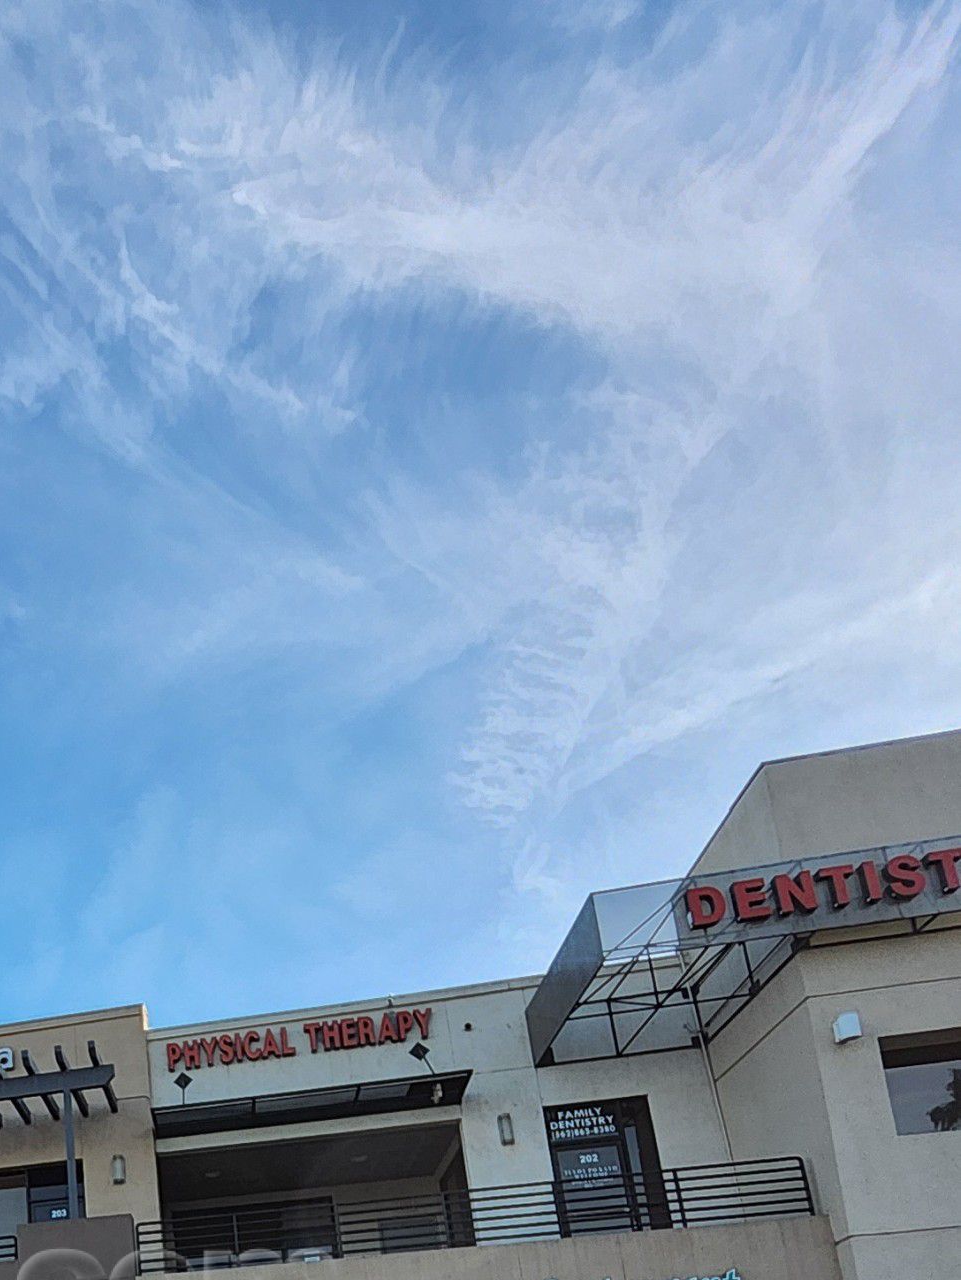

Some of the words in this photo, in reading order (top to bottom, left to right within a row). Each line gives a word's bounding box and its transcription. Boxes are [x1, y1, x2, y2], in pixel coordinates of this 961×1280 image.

[685, 847, 961, 930] DENTIST
[166, 1027, 296, 1072] PHYSICAL
[304, 1008, 432, 1053] THERAPY
[557, 1107, 602, 1120] FAMILY
[549, 1115, 614, 1130] DENTISTRY
[579, 1153, 598, 1164] 202
[51, 1209, 67, 1218] 203
